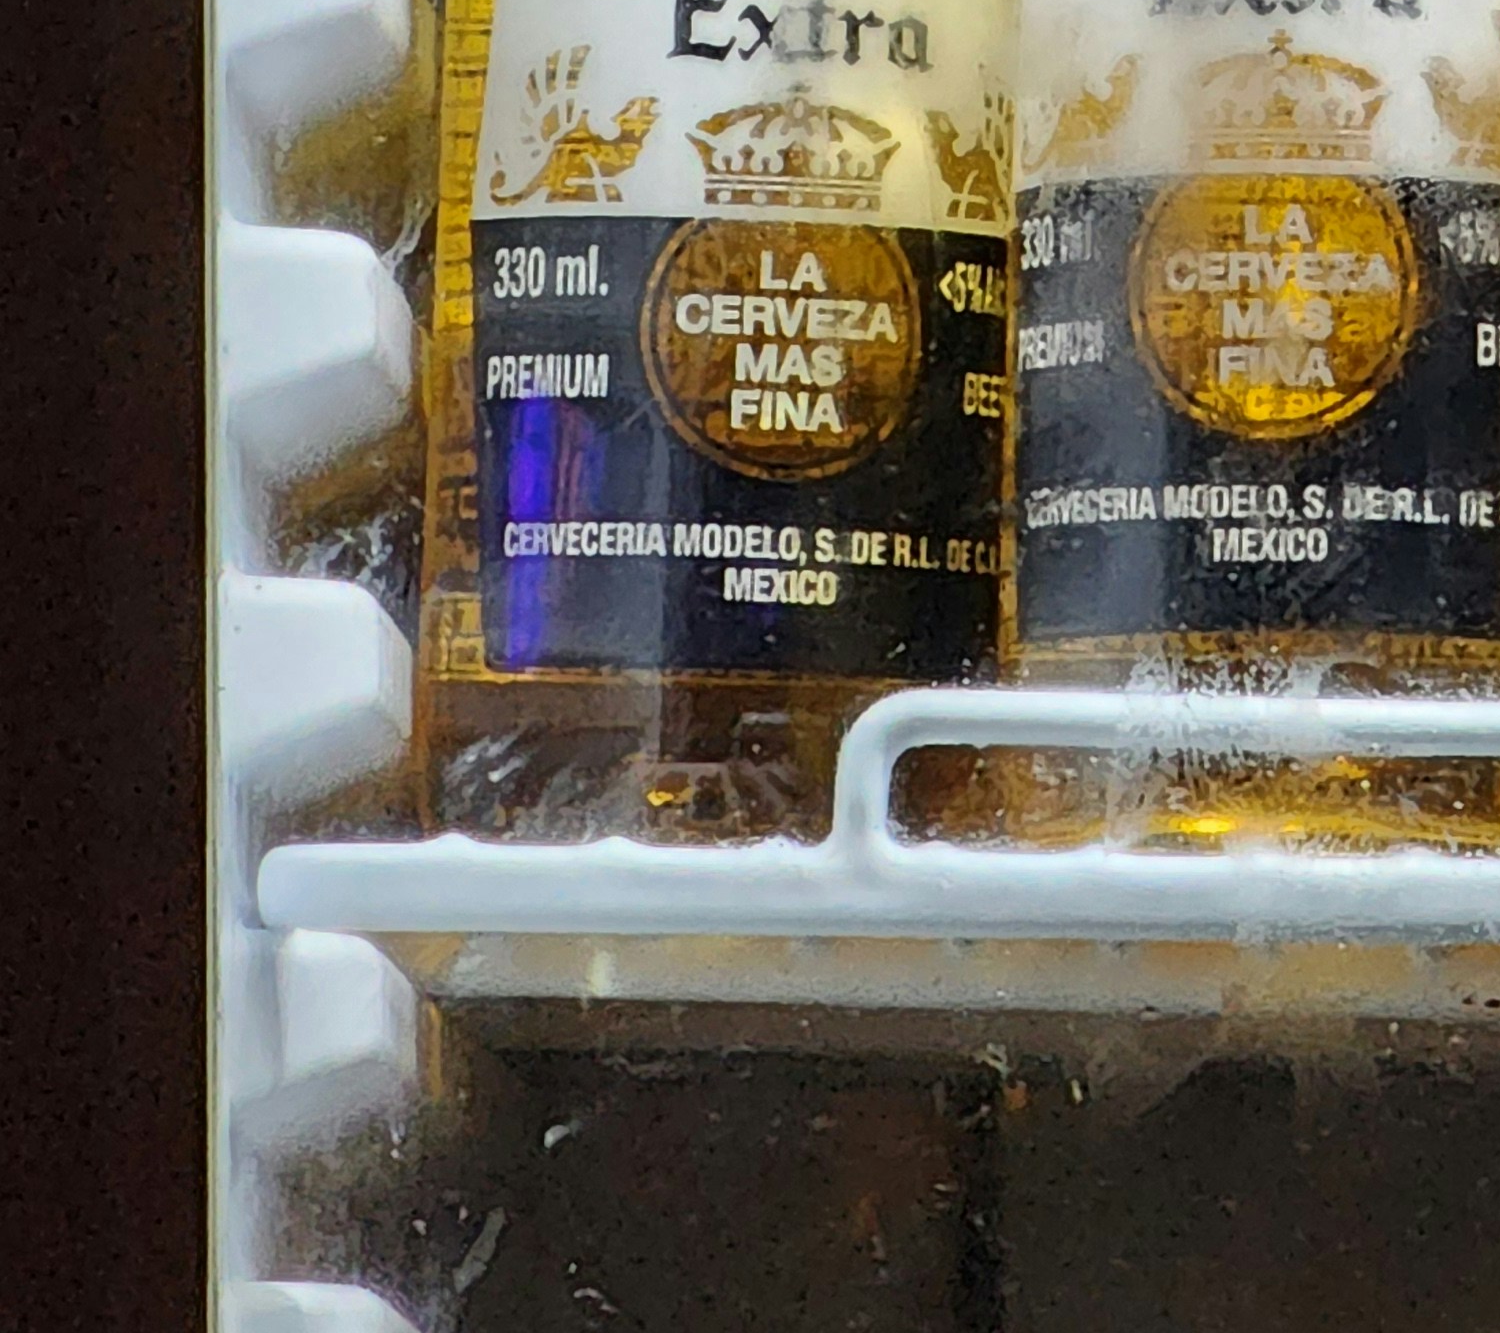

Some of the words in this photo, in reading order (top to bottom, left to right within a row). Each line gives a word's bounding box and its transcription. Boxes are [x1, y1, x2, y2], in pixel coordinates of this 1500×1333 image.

[1021, 215, 1054, 270] 330
[1243, 204, 1313, 245] LA
[493, 246, 544, 298] 330
[556, 244, 608, 296] ml.
[760, 251, 826, 292] LA
[1166, 251, 1394, 293] CERVEZA
[675, 294, 898, 343] CERVEZA
[1222, 297, 1334, 340] MAS
[486, 354, 609, 400] PREMIUM
[735, 343, 844, 386] MAS
[1219, 346, 1335, 387] FINA
[730, 389, 843, 433] FINA
[963, 371, 1007, 418] BEE
[1303, 486, 1334, 520] S.
[1459, 489, 1494, 528] DE
[503, 521, 667, 558] CERVECERIA
[673, 522, 807, 566] MODELO,
[851, 531, 887, 565] DE
[946, 538, 971, 573] DE
[1213, 527, 1328, 563] MEXICO
[723, 567, 837, 606] MEXICO
